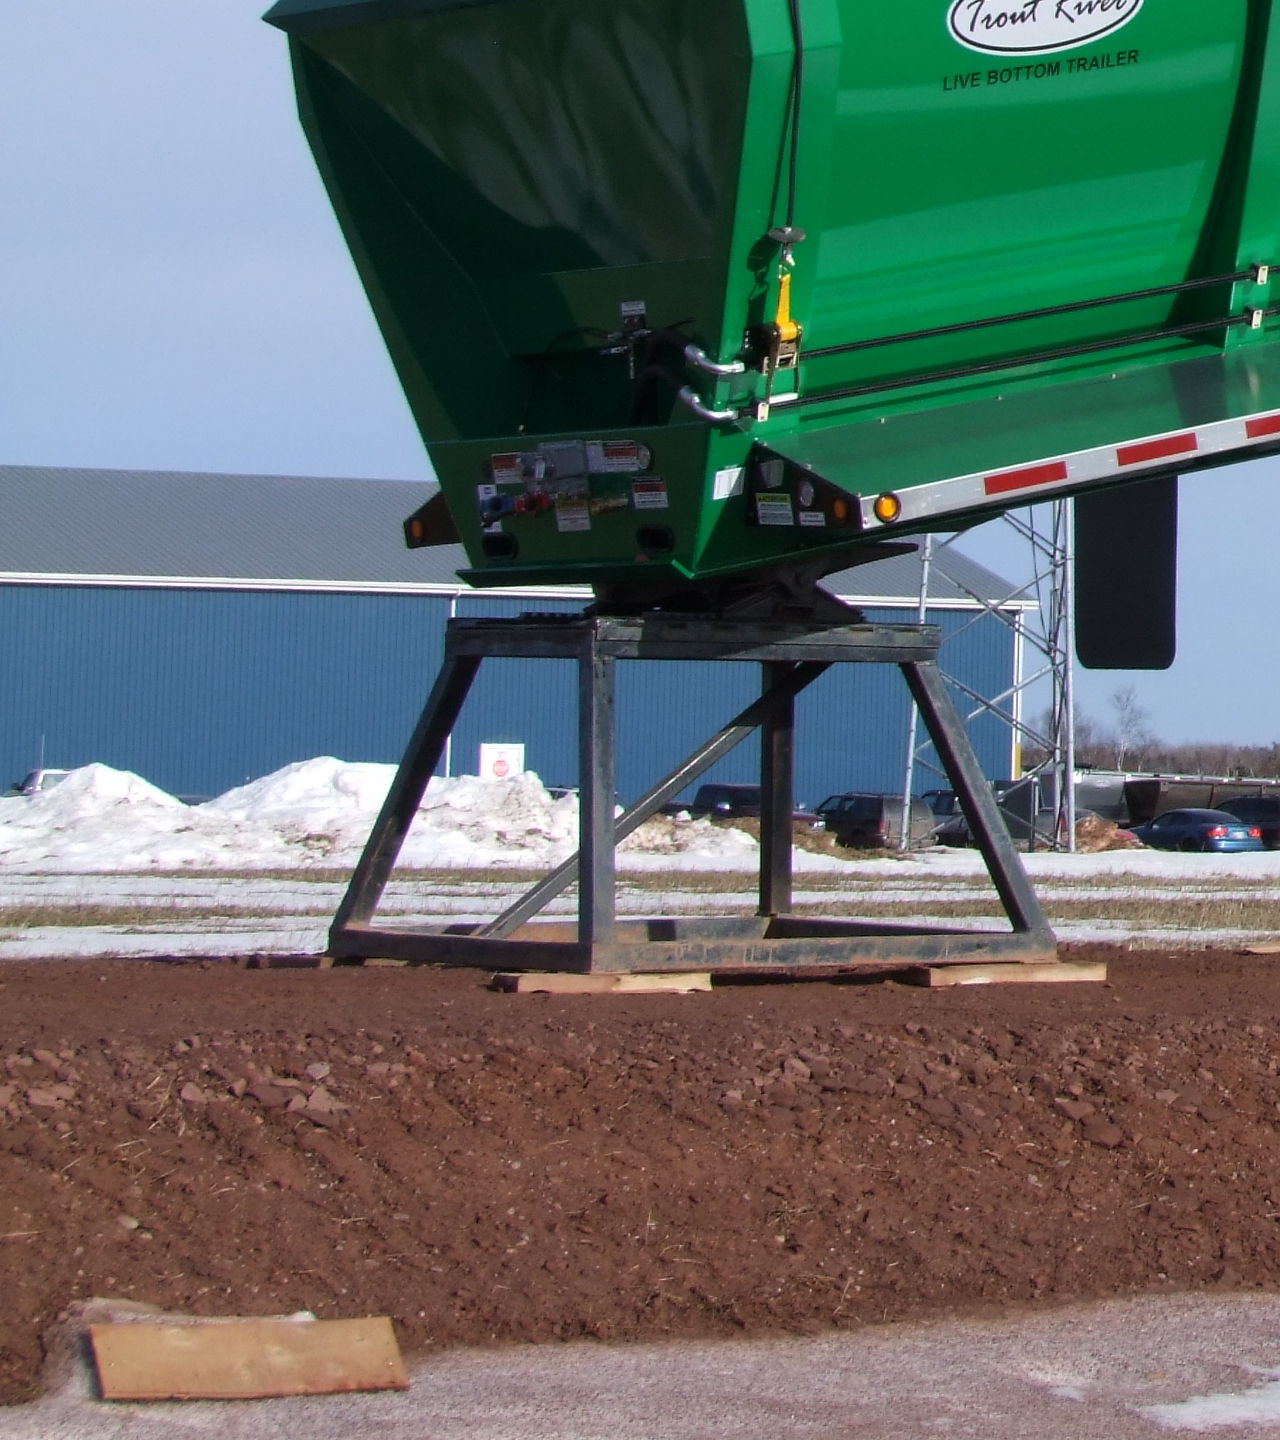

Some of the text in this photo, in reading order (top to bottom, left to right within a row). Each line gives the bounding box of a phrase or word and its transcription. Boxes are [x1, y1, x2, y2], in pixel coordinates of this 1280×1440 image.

[943, 49, 1139, 91] LIVE BOTTOM TRAILER
